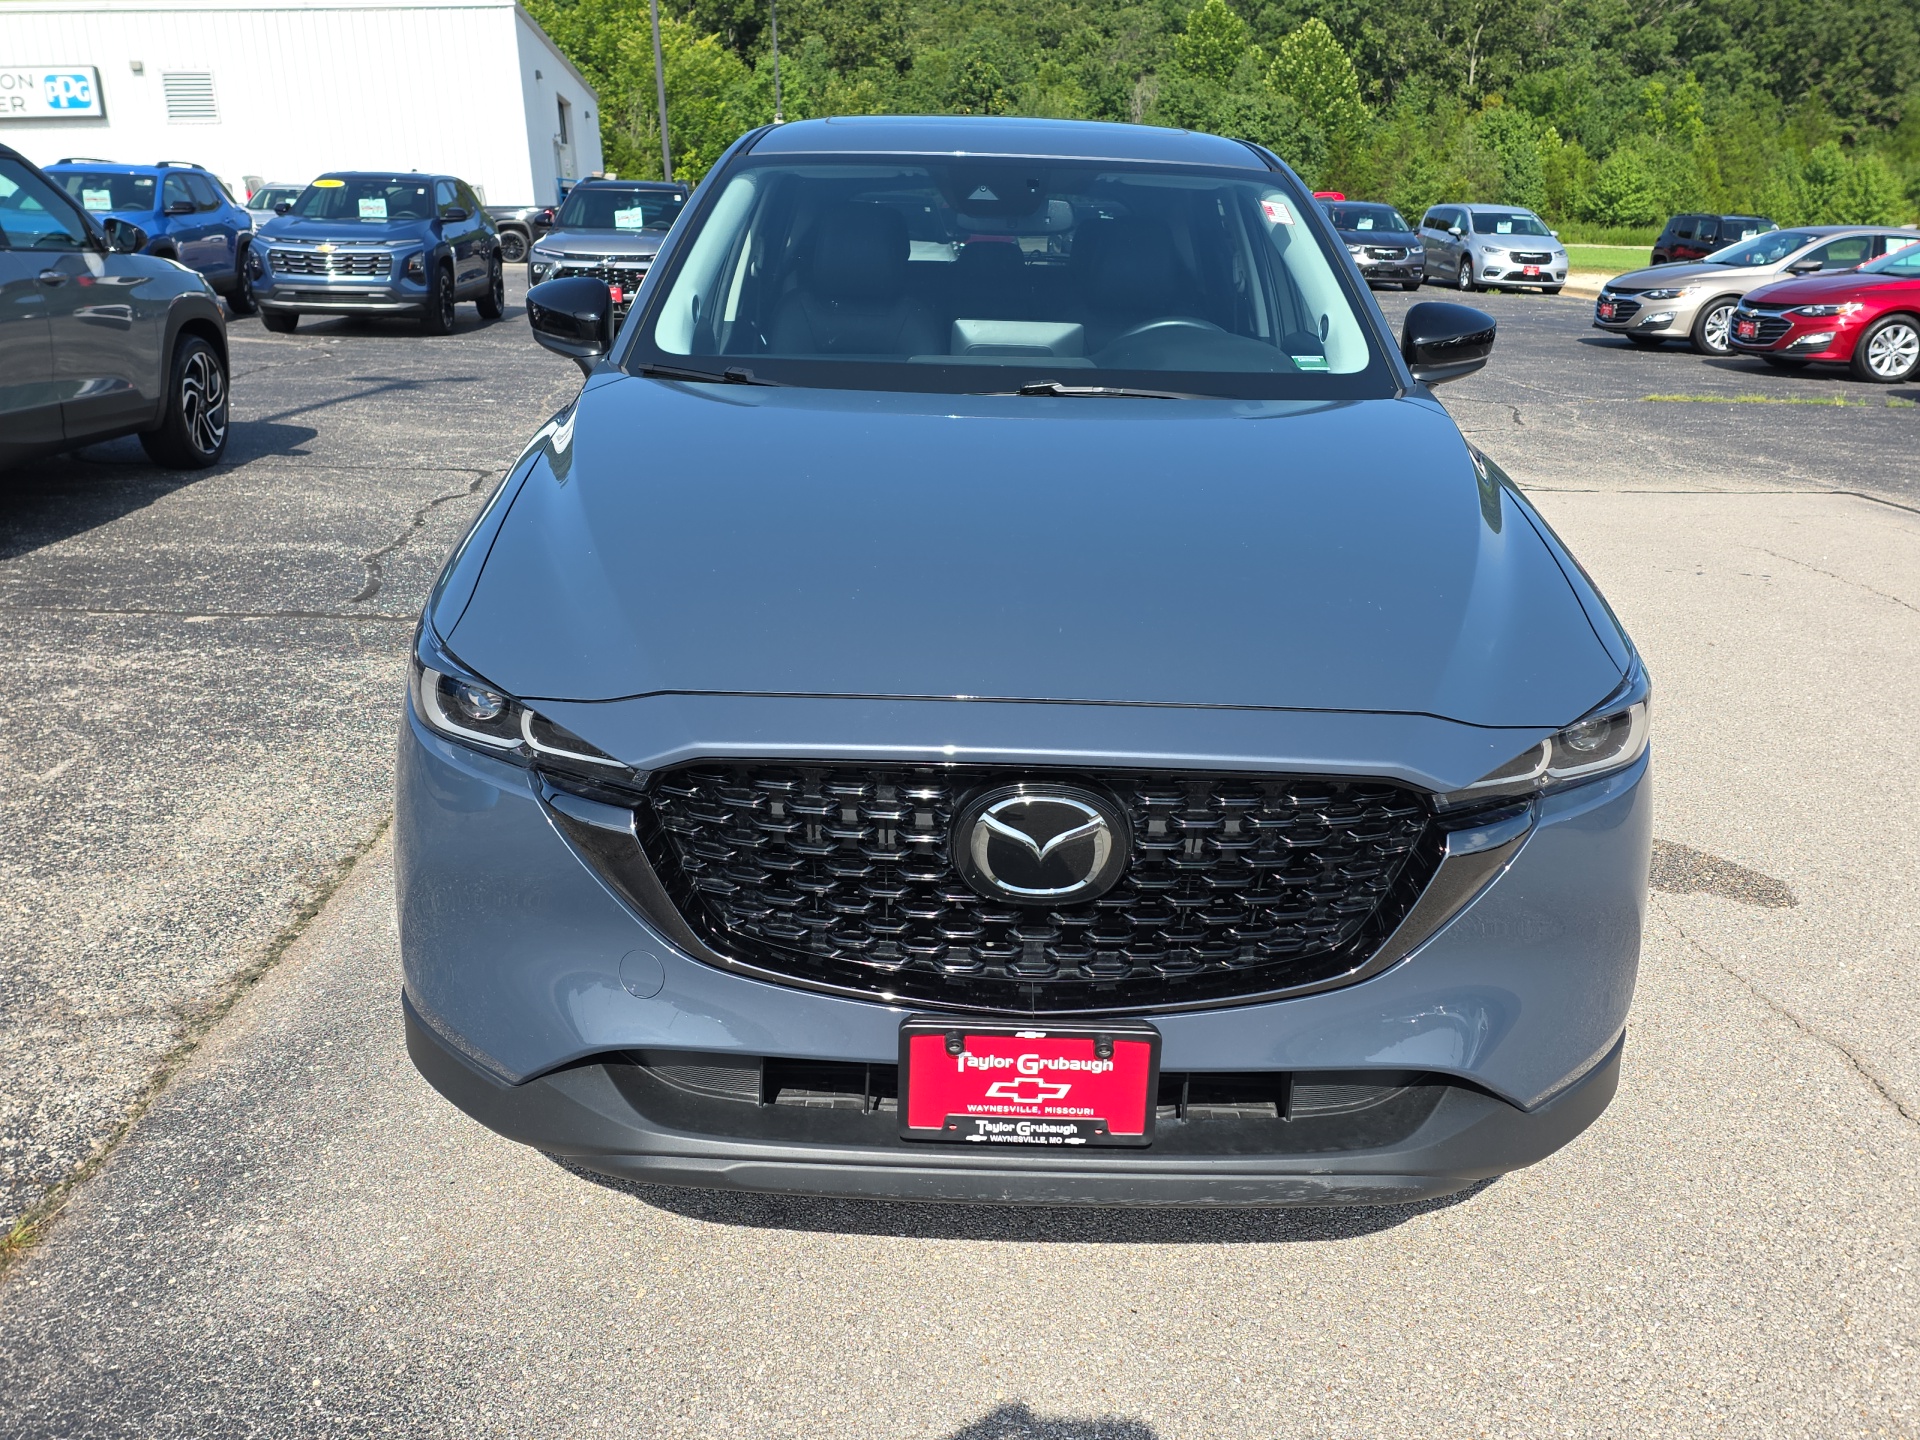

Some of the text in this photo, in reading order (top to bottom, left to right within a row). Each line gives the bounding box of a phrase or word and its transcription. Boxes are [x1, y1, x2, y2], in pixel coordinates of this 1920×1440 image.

[44, 75, 91, 108] PPG
[957, 1051, 1114, 1074] Taylor Grubaugh
[967, 1104, 1094, 1115] WAYNESVILLE, MISSOURI
[975, 1120, 1078, 1135] Taylor Grubaugh
[990, 1135, 1048, 1144] WAYNESVILLE,
